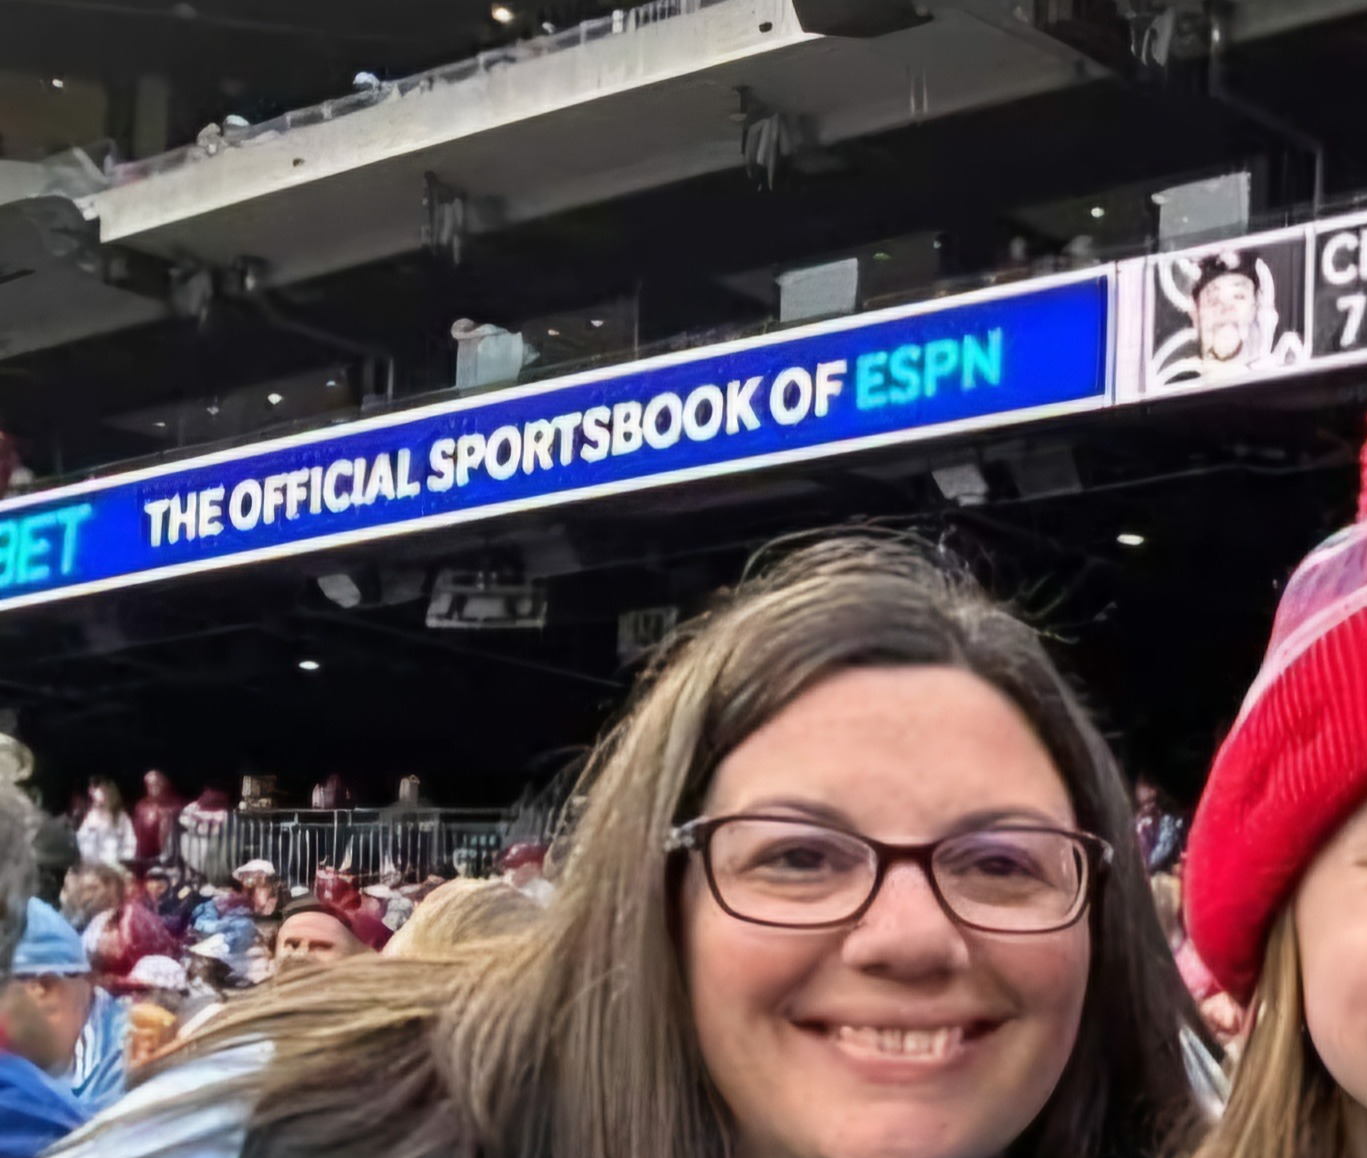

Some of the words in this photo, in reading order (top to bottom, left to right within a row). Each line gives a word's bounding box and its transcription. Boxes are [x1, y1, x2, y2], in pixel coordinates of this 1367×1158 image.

[144, 484, 225, 548] THE
[227, 446, 421, 534] OFFICIAL
[426, 374, 765, 493] SPORTSBOOK
[769, 359, 848, 427] OF
[855, 325, 1004, 411] ESPN
